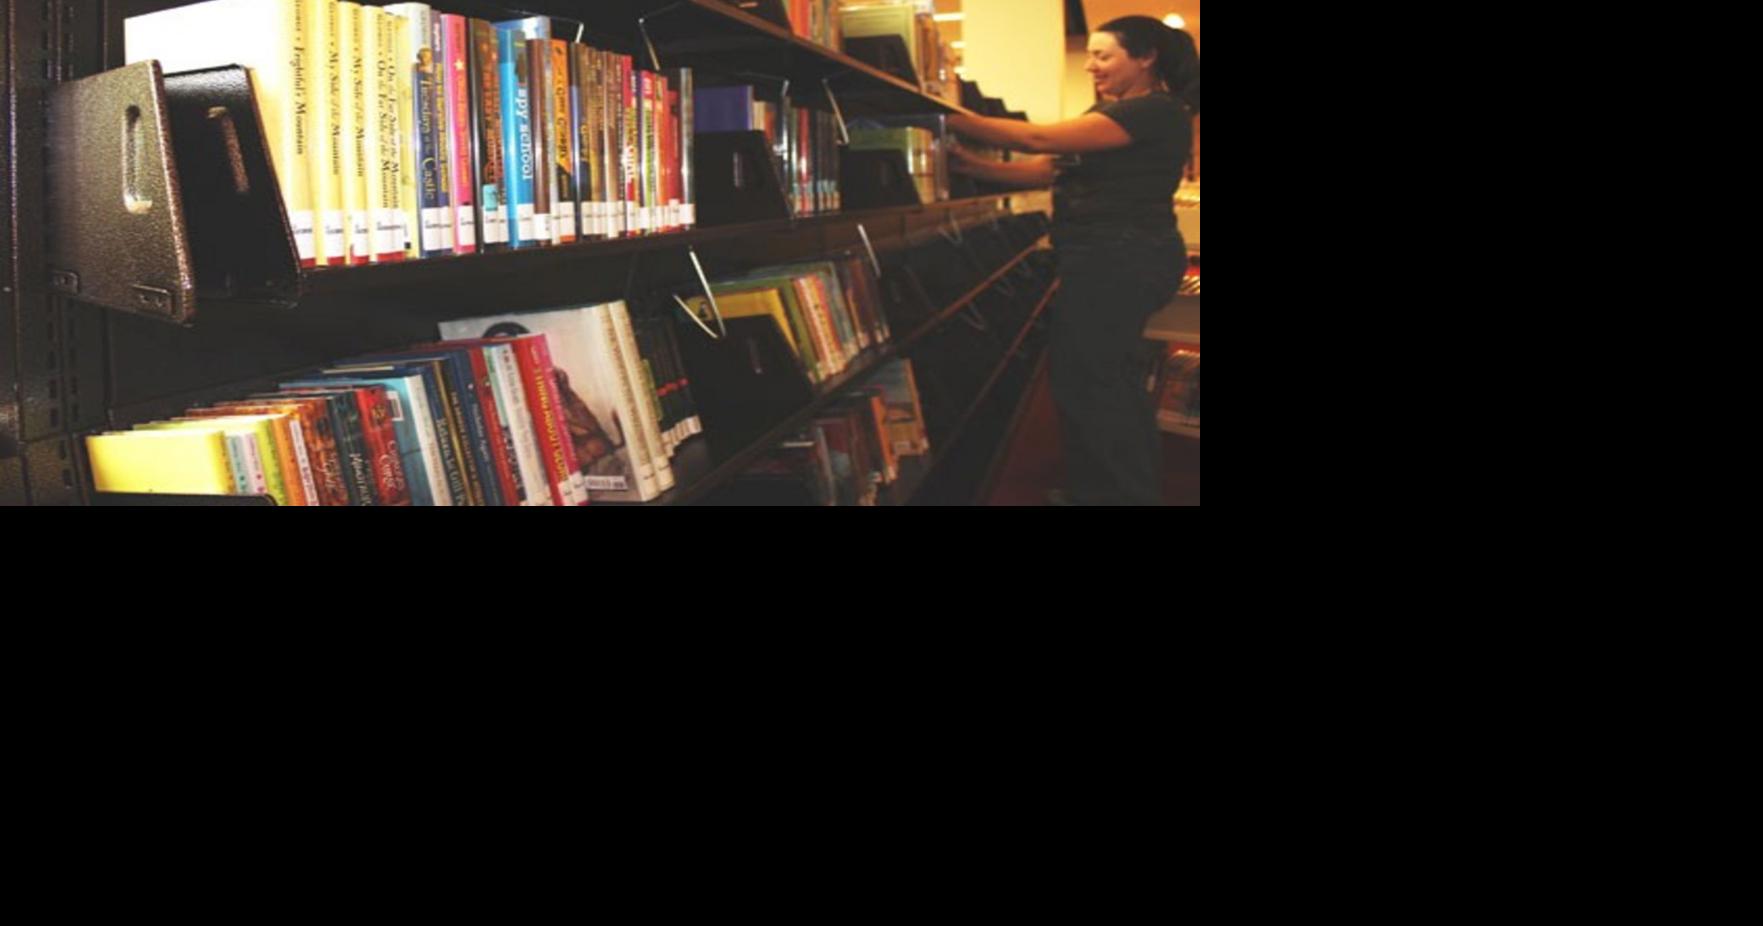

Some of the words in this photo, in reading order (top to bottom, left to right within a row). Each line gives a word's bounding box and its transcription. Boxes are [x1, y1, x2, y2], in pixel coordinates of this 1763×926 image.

[325, 50, 339, 69] My
[350, 55, 363, 74] My
[378, 60, 386, 77] On
[387, 65, 396, 81] On
[329, 72, 340, 94] Side
[353, 77, 363, 98] Side
[378, 93, 387, 108] Far
[420, 79, 435, 134] Tuesdays
[515, 87, 529, 119] spy
[295, 101, 306, 155] Mountain
[379, 111, 388, 132] Side
[389, 115, 398, 136] Side
[331, 122, 341, 175] Mountain
[355, 126, 365, 177] Mountain
[519, 123, 533, 180] school
[381, 159, 391, 208] Mountain
[391, 162, 400, 209] Mountain
[422, 157, 437, 200] Castle
